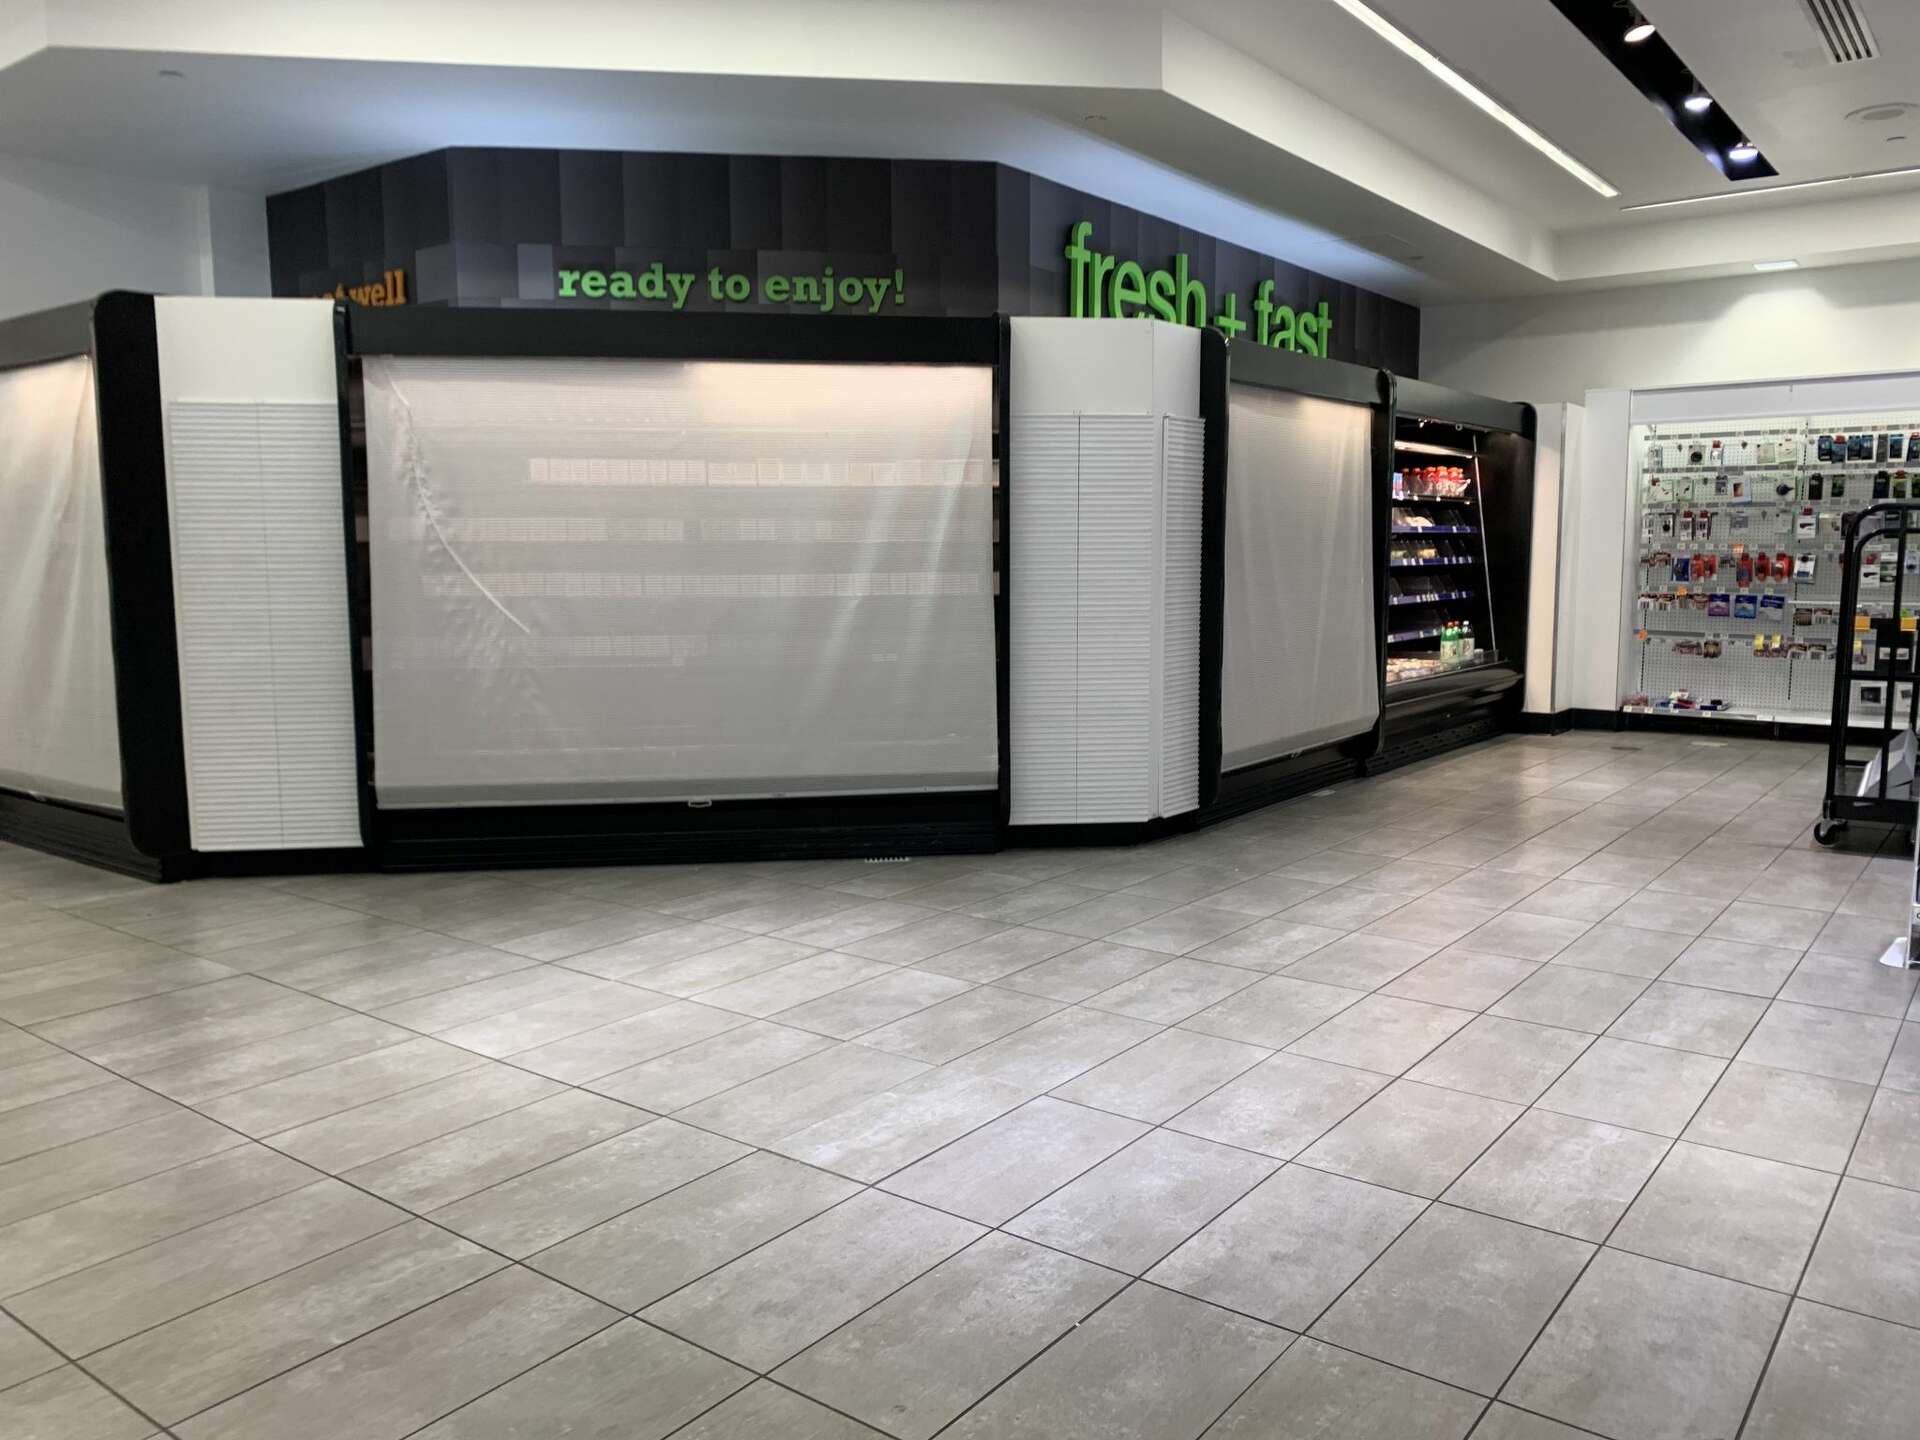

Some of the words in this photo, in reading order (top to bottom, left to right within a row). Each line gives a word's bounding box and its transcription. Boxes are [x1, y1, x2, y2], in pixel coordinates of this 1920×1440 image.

[348, 268, 406, 306] well
[558, 262, 695, 310] ready
[708, 266, 750, 301] to
[764, 266, 905, 313] enjoy!
[1065, 221, 1207, 327] fresh
[1255, 279, 1332, 358] fast
